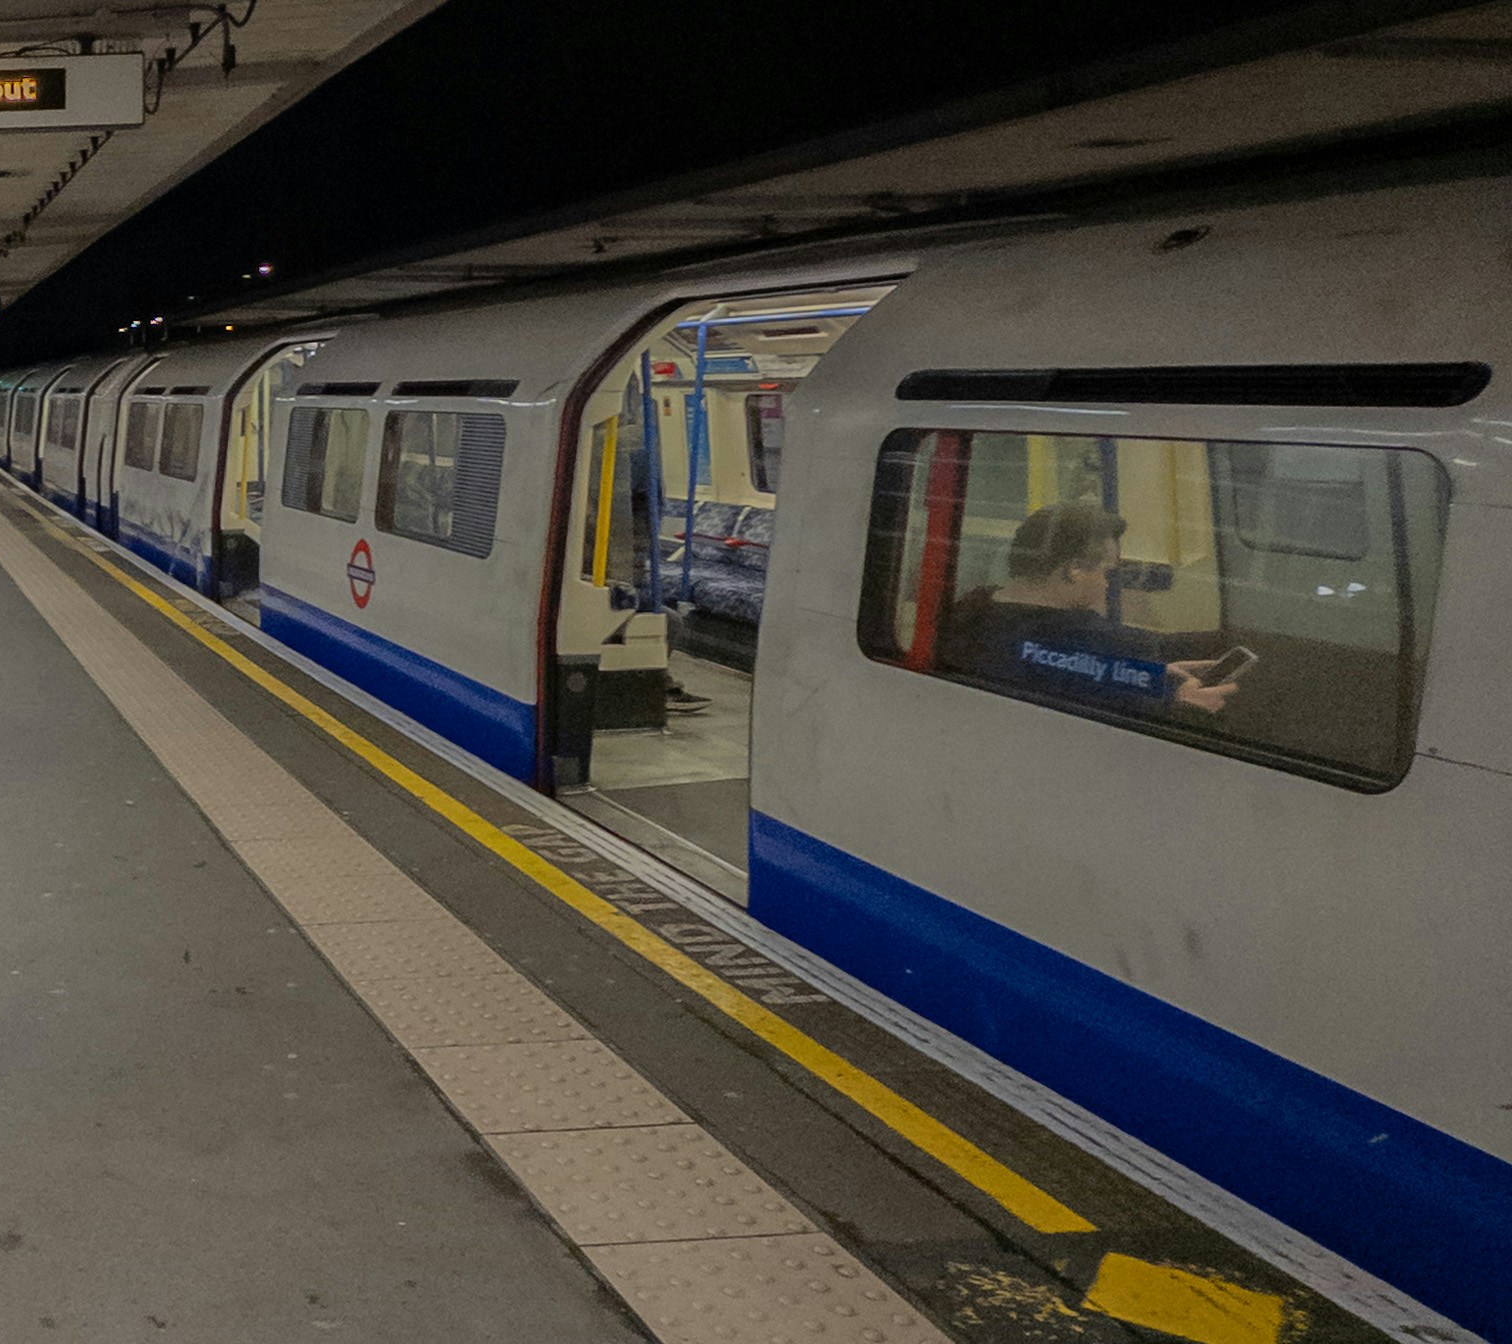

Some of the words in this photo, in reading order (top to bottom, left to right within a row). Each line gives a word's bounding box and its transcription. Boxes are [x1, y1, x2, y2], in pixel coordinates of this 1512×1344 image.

[1021, 640, 1108, 682] Piccadilly
[1112, 659, 1152, 688] line
[571, 869, 681, 915] THE
[658, 922, 834, 1005] MIND
